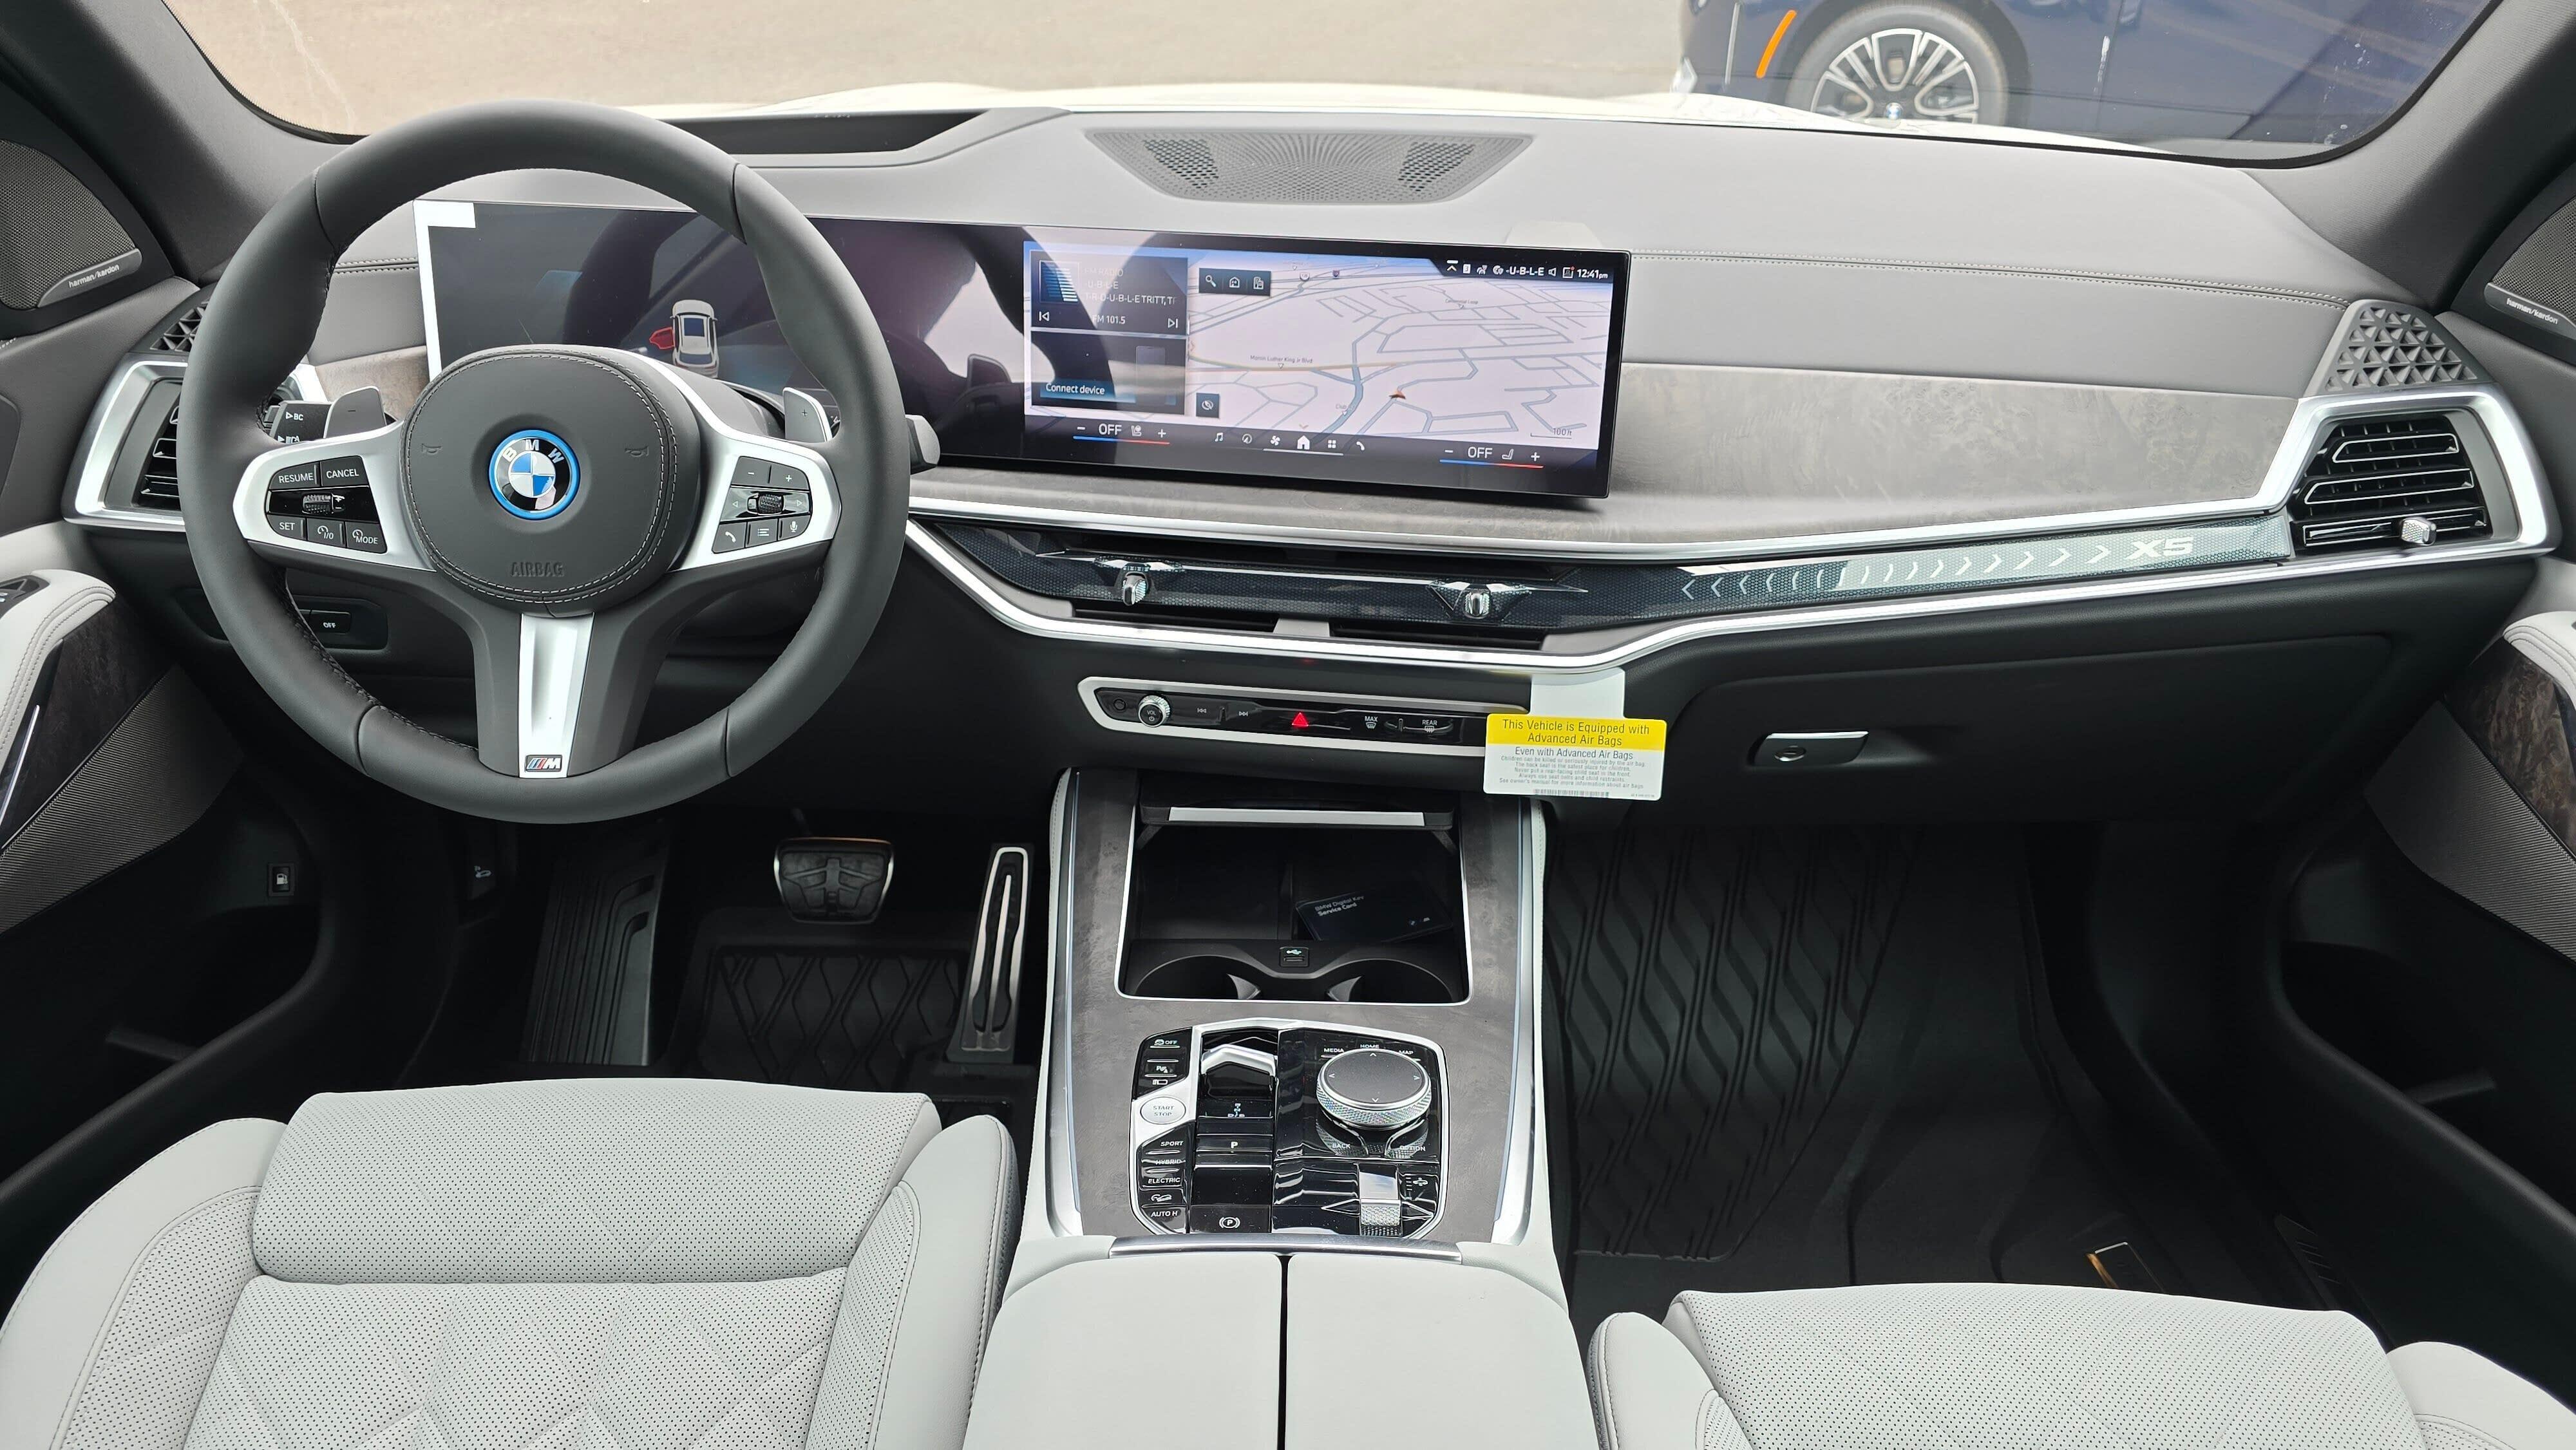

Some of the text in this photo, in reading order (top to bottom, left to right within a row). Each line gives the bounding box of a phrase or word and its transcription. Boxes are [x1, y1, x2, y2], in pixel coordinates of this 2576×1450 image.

[68, 264, 120, 288] harman/kardon
[1099, 268, 1123, 277] RADIO
[1141, 295, 1166, 306] TRITT,
[2506, 297, 2559, 325] harman/kardon
[1092, 315, 1126, 325] FM 101.5
[1045, 382, 1105, 395] Connect device
[1098, 423, 1122, 435] OFF
[1553, 428, 1566, 436] 100
[501, 439, 565, 464] BMW
[1467, 446, 1493, 458] OFF
[278, 468, 359, 484] RESUME CANCEL
[279, 522, 296, 531] SET
[355, 536, 379, 544] MODE
[2125, 536, 2194, 560] X5
[511, 561, 565, 578] AIRBAG
[1502, 719, 1650, 735] This Vehicle is Equipped with
[1528, 732, 1622, 748] Advanced Air Bags
[1515, 746, 1634, 760] Even with Advanced Air Bags
[1231, 1141, 1238, 1149] P
